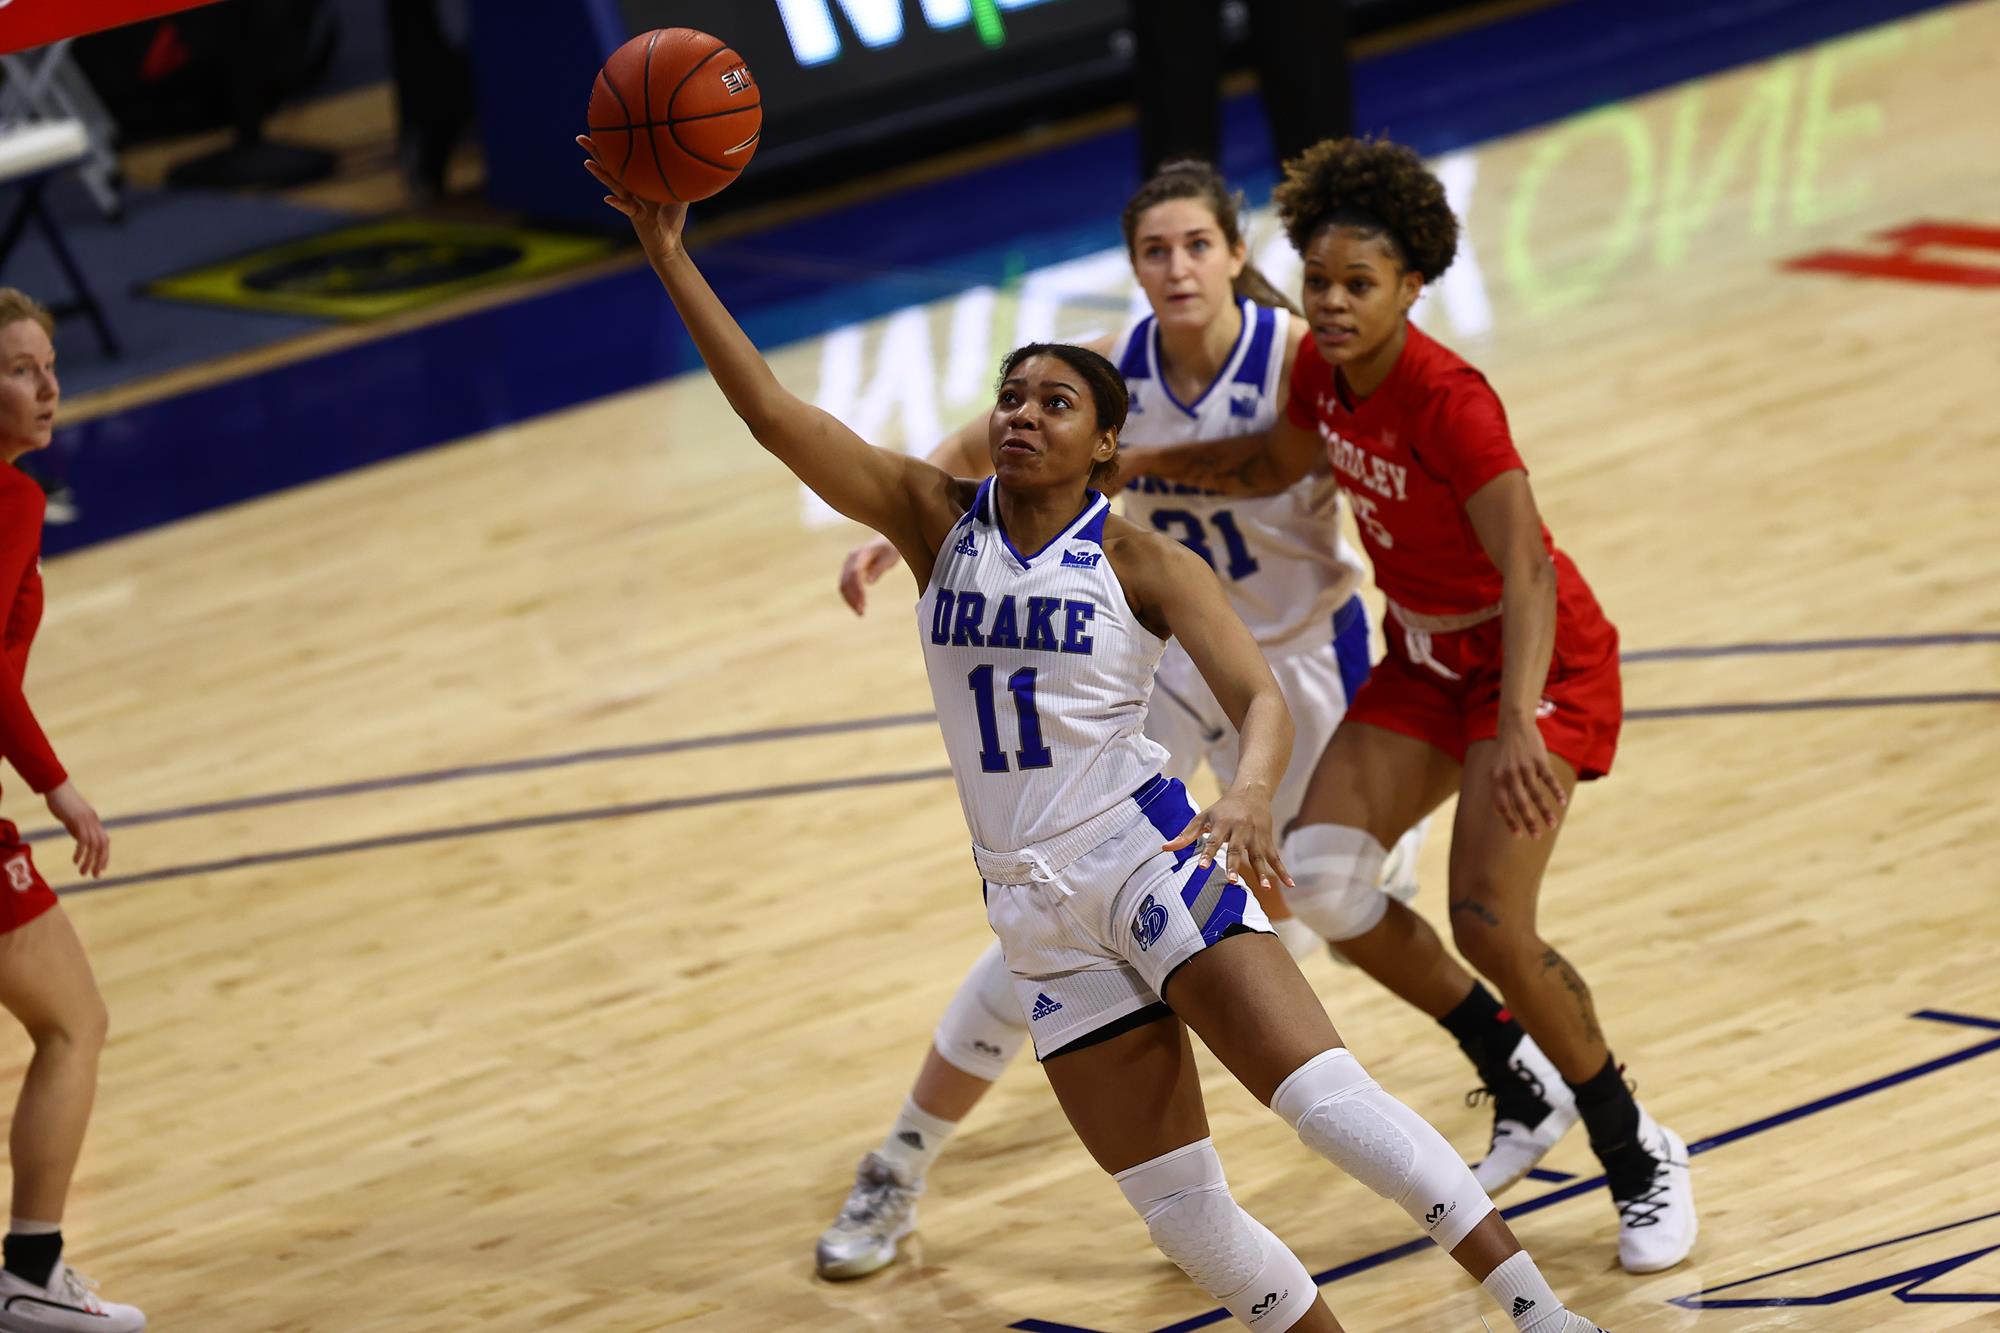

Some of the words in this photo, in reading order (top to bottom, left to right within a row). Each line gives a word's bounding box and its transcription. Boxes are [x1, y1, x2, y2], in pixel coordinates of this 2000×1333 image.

[931, 587, 1095, 656] DRAKE
[968, 664, 1053, 773] 11
[1032, 1002, 1063, 1021] adidas
[1512, 1300, 1536, 1319] adidas
